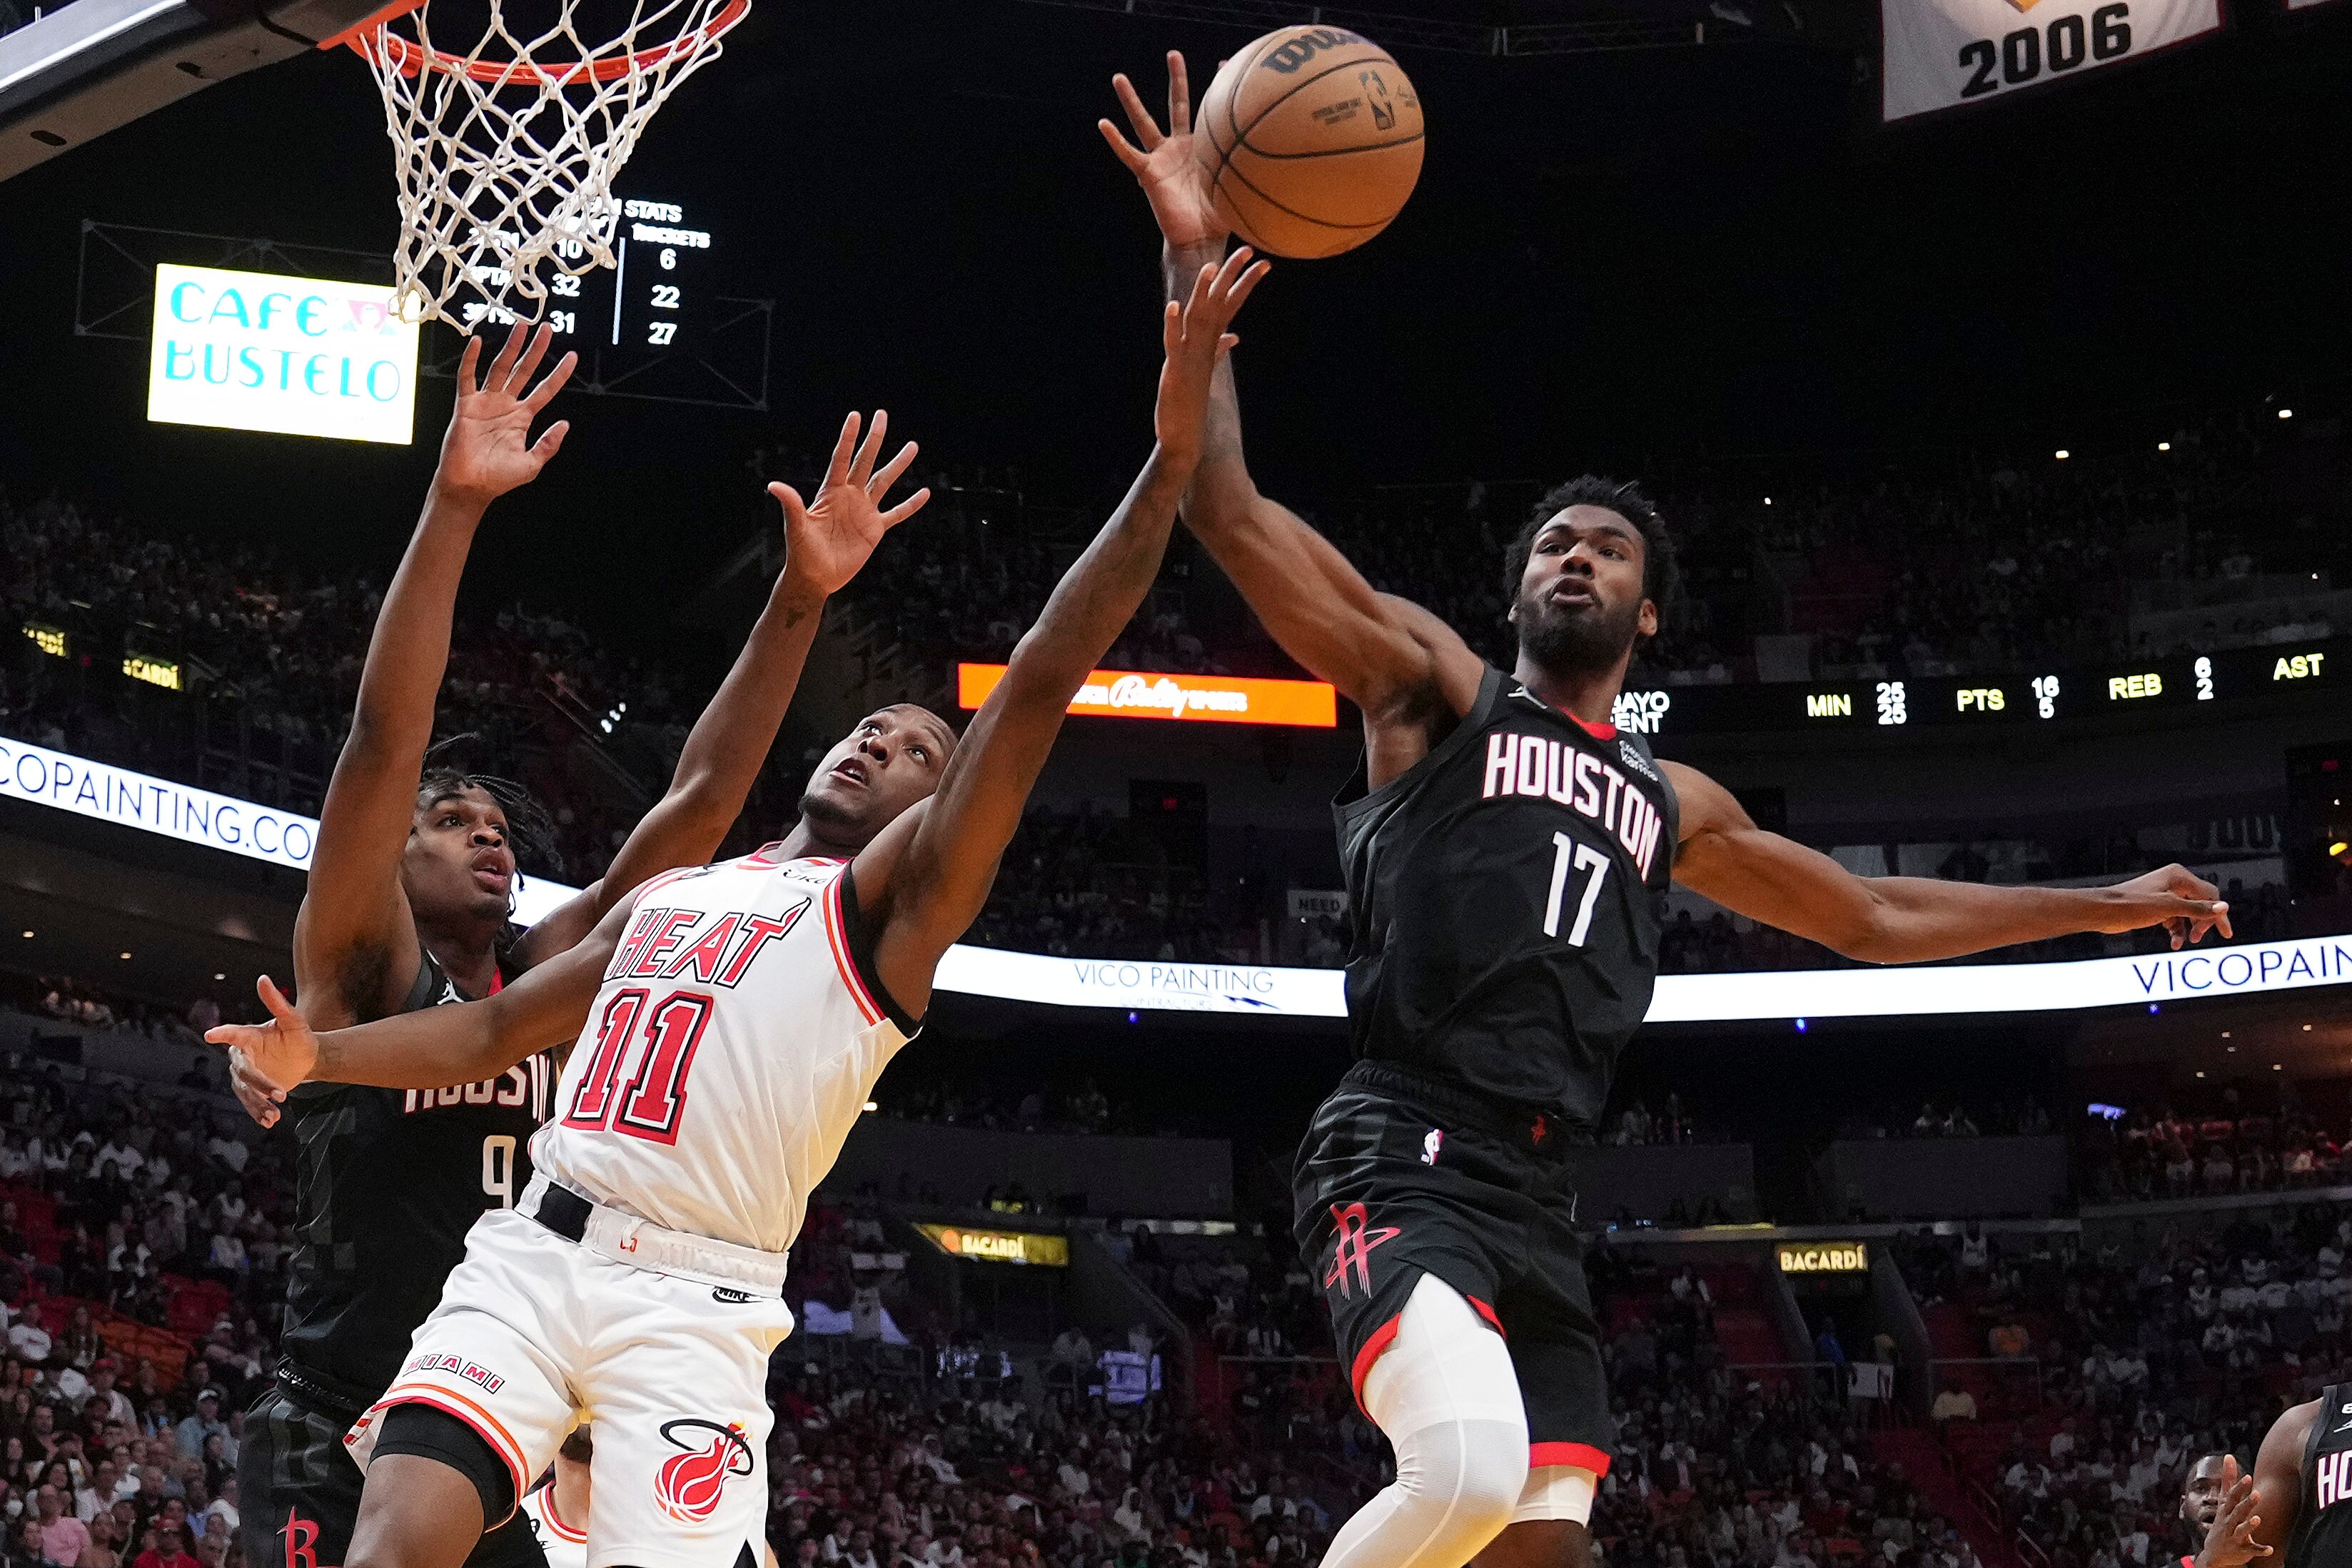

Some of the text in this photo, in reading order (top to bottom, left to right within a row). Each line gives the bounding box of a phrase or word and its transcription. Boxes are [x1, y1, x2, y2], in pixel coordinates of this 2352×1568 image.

[1959, 2, 2131, 98] 2006
[625, 199, 682, 223] STATS
[632, 223, 711, 248] ROCKETS
[557, 238, 583, 259] 10
[660, 248, 677, 270] 6
[552, 273, 581, 297] 32
[650, 285, 680, 308] 22
[549, 310, 575, 334] 31
[648, 322, 677, 345] 27
[166, 340, 400, 402] BUSTELO
[2194, 657, 2212, 678] 6
[2273, 653, 2324, 680] AST
[1876, 682, 1905, 703] 25
[2031, 675, 2059, 699] 16
[2109, 673, 2162, 700] REB
[2196, 678, 2214, 700] 2
[1807, 694, 1851, 717] MIN
[1877, 703, 1907, 724] 25
[1957, 689, 2004, 712] PTS
[2039, 697, 2054, 719] 5
[1610, 712, 1663, 733] ENT
[1483, 733, 1662, 882] HOUSTON
[1543, 831, 1610, 947] 17
[602, 897, 812, 988] HEAT
[1075, 963, 1273, 993] VICO PAINTING
[560, 988, 713, 1146] 11
[483, 1135, 516, 1213] 9
[403, 1354, 505, 1395] MIAMI
